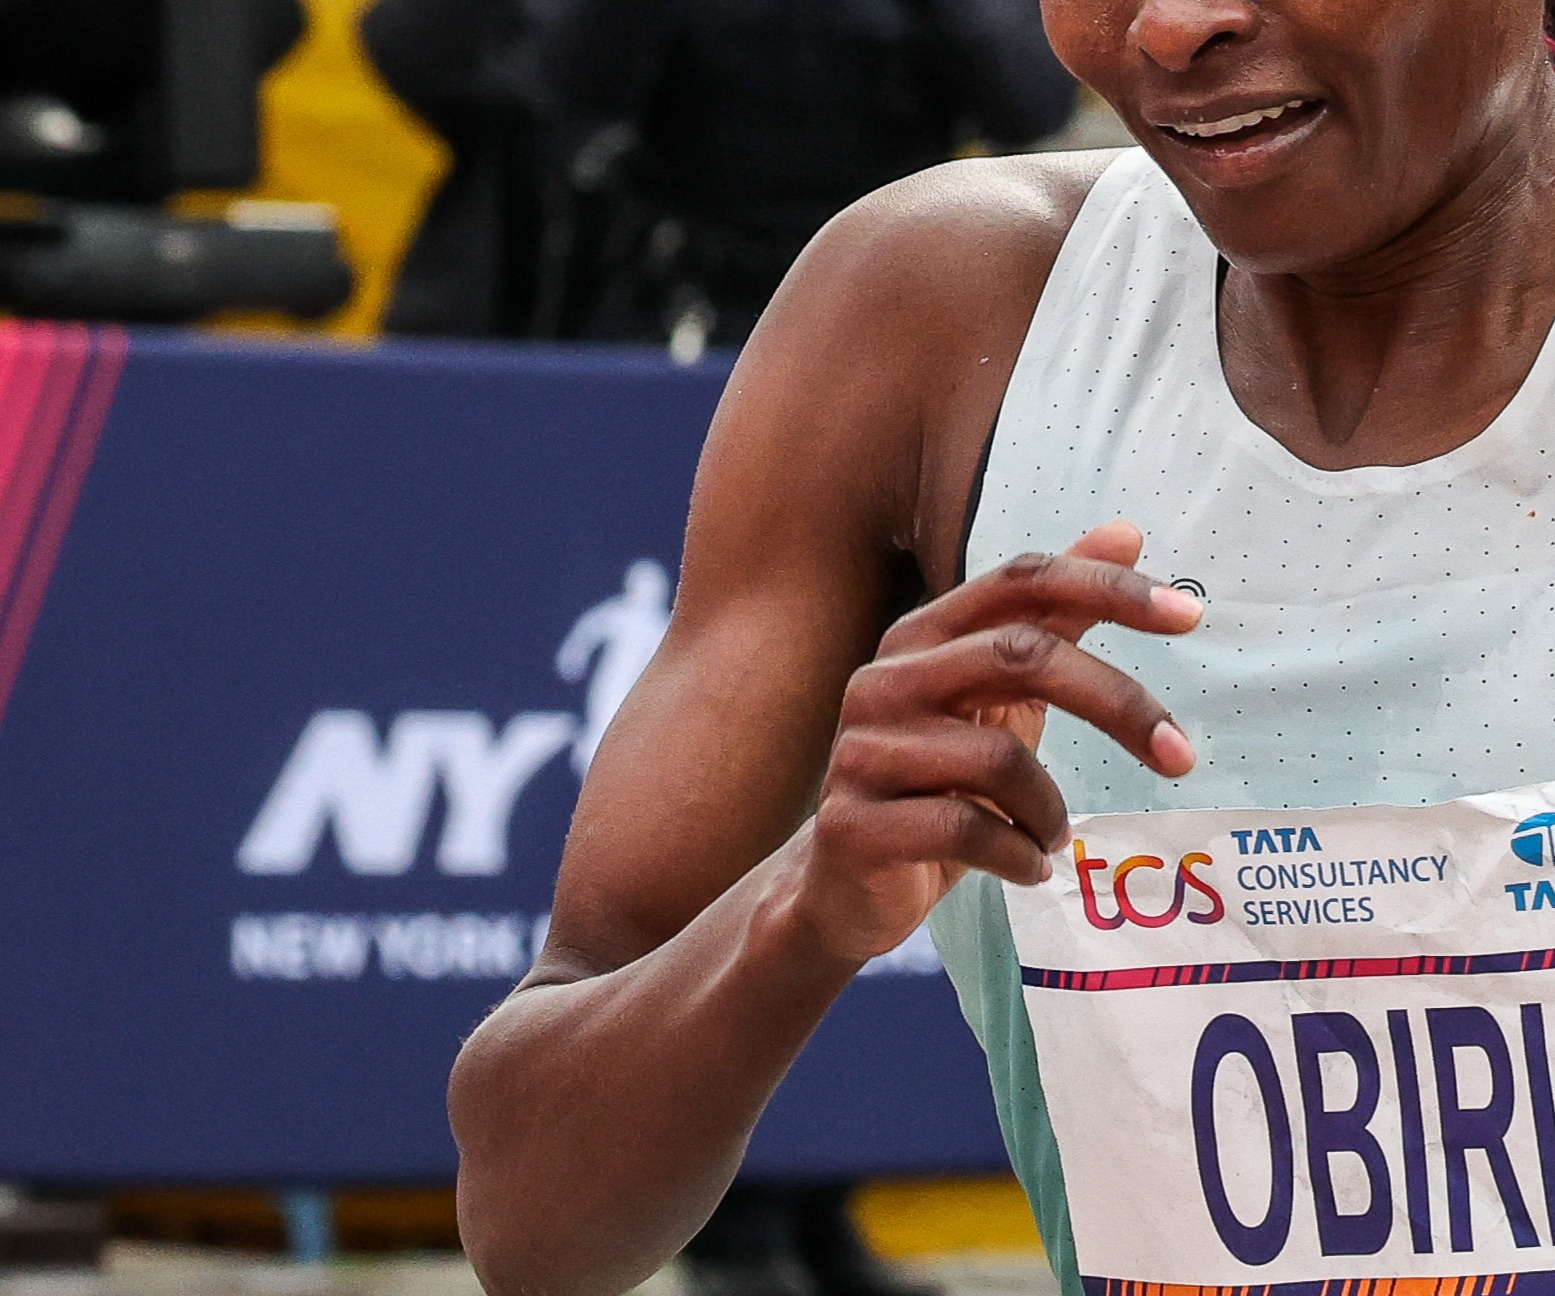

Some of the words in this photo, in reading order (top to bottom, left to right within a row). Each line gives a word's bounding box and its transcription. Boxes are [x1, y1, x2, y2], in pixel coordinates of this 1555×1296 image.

[1231, 827, 1322, 855] TATA
[1073, 839, 1225, 930] tcs
[1238, 855, 1448, 891] CONSULTANCY
[1243, 896, 1375, 926] SERVICES
[229, 911, 370, 980] NEW
[376, 912, 527, 980] YORK
